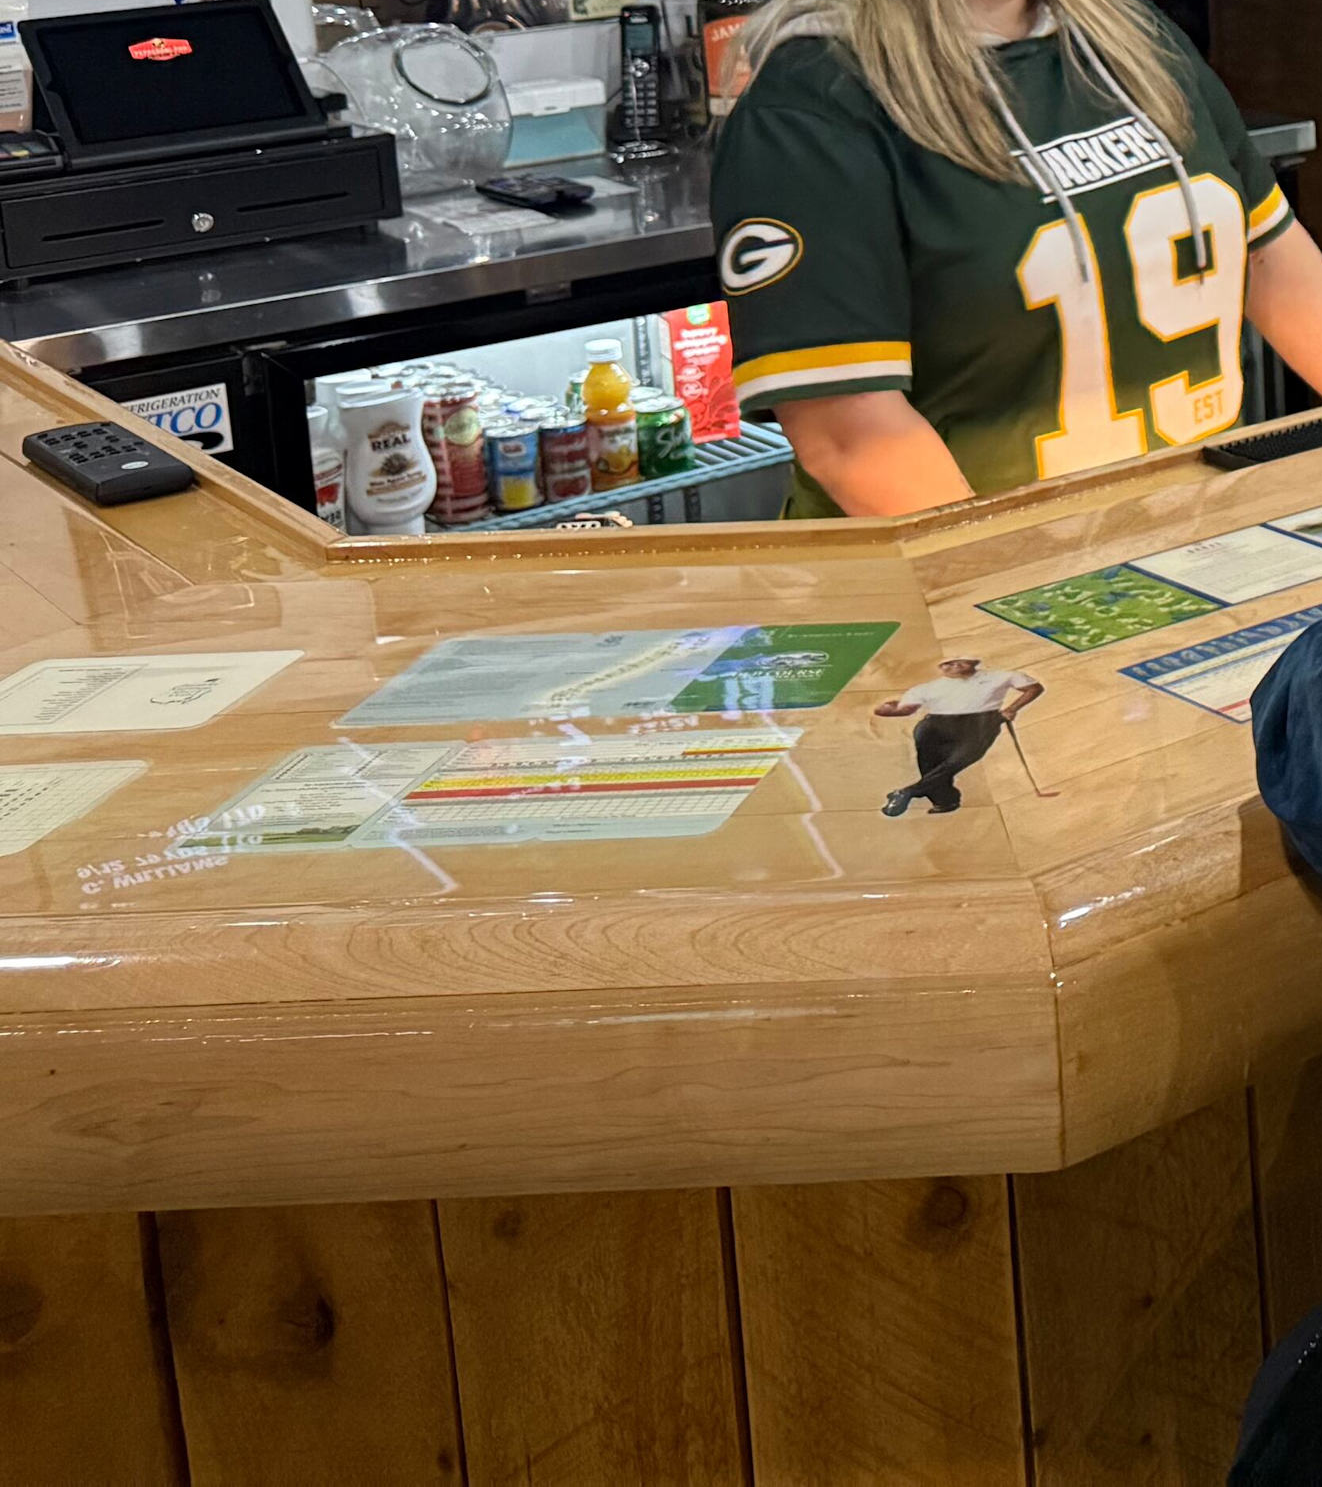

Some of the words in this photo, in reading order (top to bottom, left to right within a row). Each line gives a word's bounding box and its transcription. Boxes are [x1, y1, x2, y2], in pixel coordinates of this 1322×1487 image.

[1015, 172, 1248, 481] 19
[129, 387, 221, 413] FRIGERATION
[1193, 389, 1224, 425] EST
[145, 402, 222, 434] TCO
[371, 433, 411, 452] REAL
